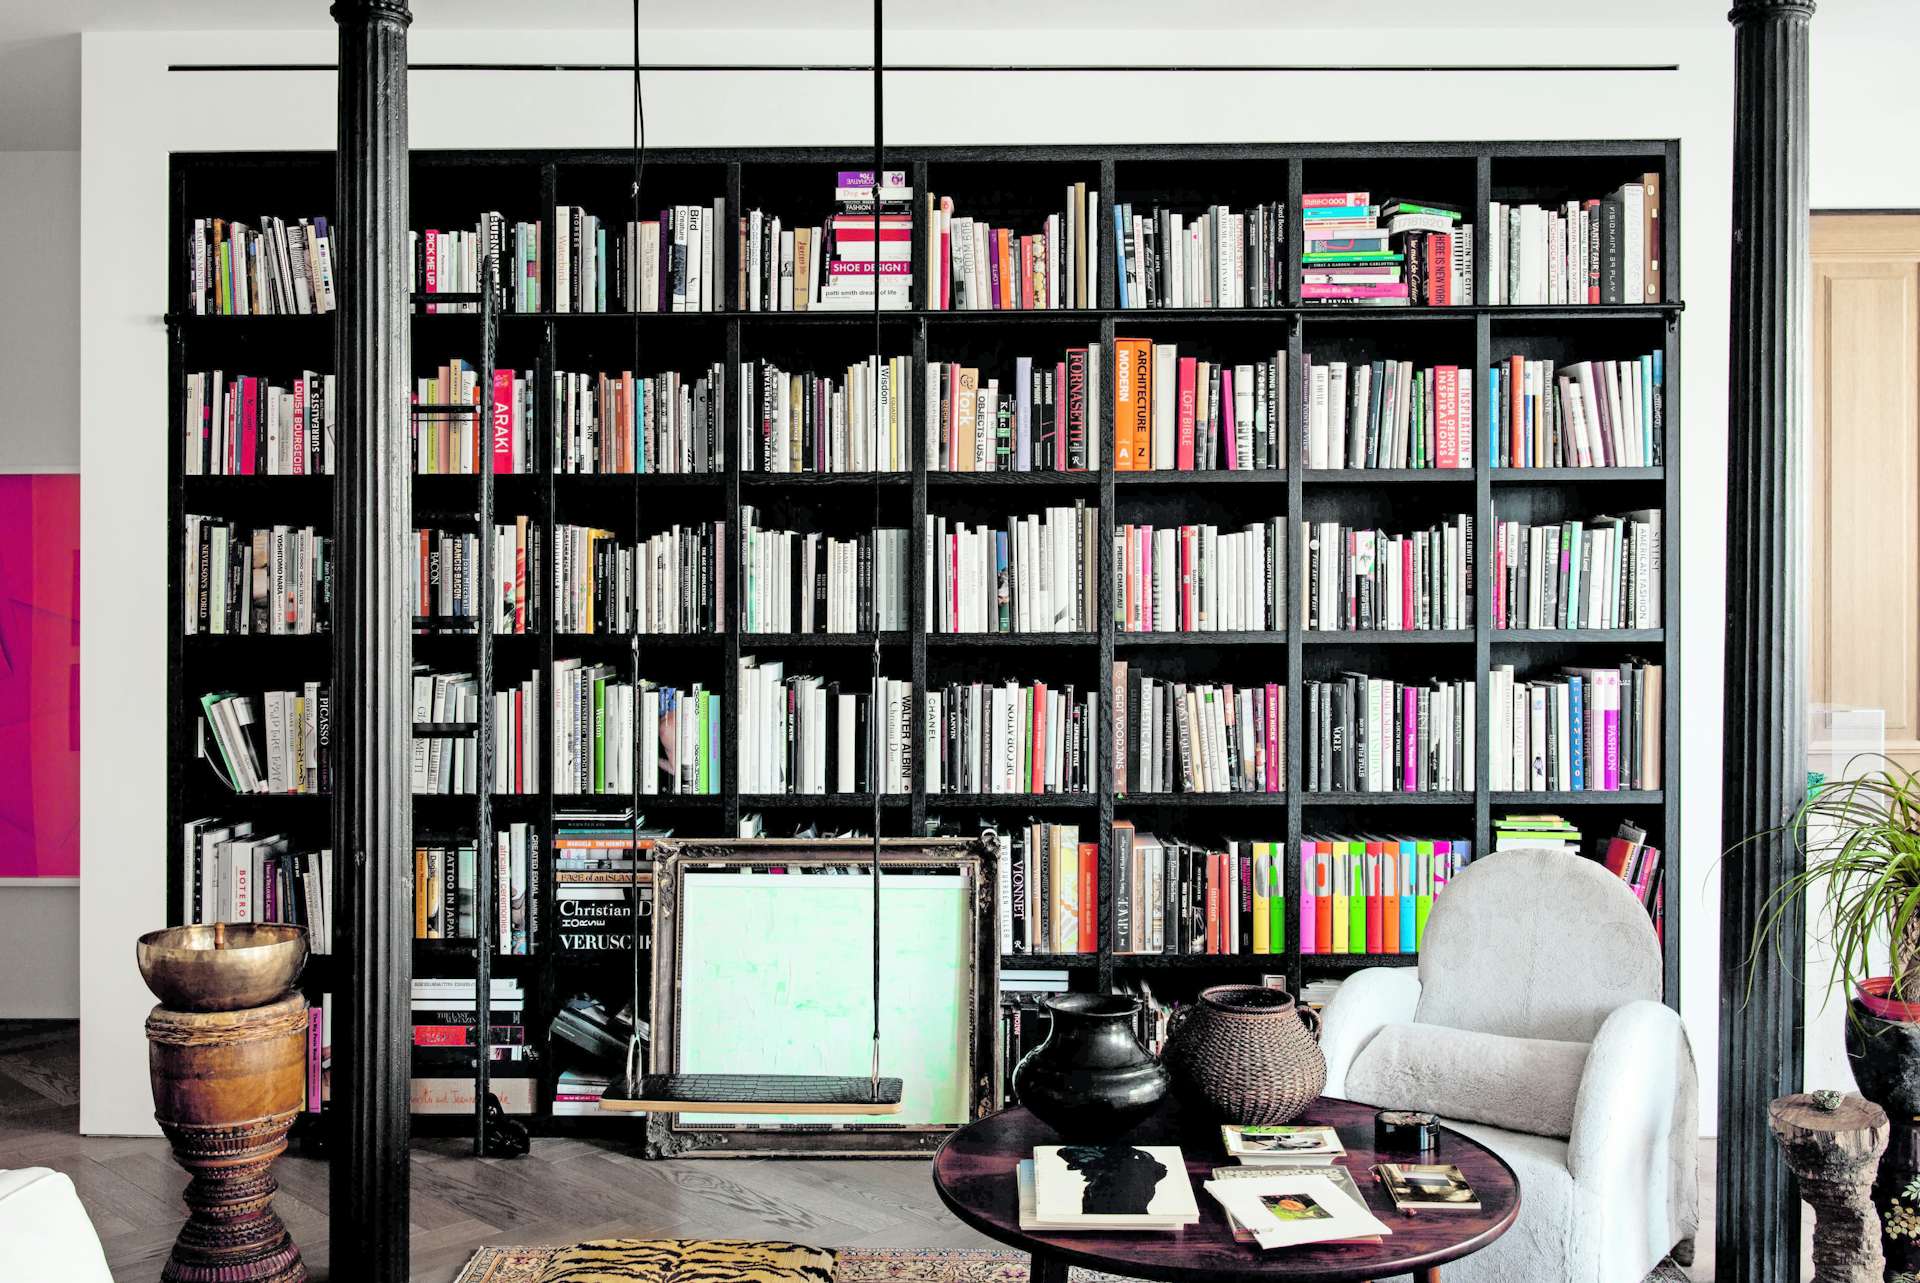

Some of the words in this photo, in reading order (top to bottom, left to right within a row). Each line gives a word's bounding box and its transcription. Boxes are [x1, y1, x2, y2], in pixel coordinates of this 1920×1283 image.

[678, 210, 686, 241] Creature
[689, 209, 700, 231] Bird
[1277, 204, 1285, 220] Tord
[196, 227, 204, 262] MARILYN
[427, 233, 435, 254] PICK
[1277, 220, 1285, 243] Boontje
[1435, 236, 1445, 257] HERE
[197, 263, 205, 290] MINTER
[427, 256, 435, 270] ME
[557, 235, 567, 286] Waterbirds
[833, 264, 860, 272] SHOE
[991, 263, 1000, 286] LOFTS
[1436, 266, 1446, 284] NEW
[427, 272, 436, 285] UP
[1436, 284, 1446, 304] YORK
[881, 368, 889, 405] Wisdom
[1119, 349, 1129, 402] MODERN
[1137, 349, 1147, 432] ARCHITECTURE
[294, 381, 303, 414] LOUISE
[960, 391, 976, 426] fork
[1070, 354, 1083, 442] FORNASETTI
[1182, 390, 1192, 415] LOFT
[311, 393, 320, 452] SURREALISTS
[495, 402, 508, 453] ARAKI
[1182, 417, 1192, 446] BIBLE
[293, 417, 303, 474] BOURGEOIS
[201, 544, 209, 589] NEVELSON'S
[430, 552, 439, 584] BACON
[454, 539, 462, 571] FRANCIS
[1639, 528, 1647, 576] AMERICAN
[454, 573, 462, 599] BACON
[1639, 579, 1647, 620] FASHION
[200, 591, 208, 618] WORLD
[1115, 686, 1124, 714] GERT
[1142, 684, 1150, 738] DOMESTIC
[319, 697, 329, 745] PICASSO
[595, 707, 604, 738] Weston
[890, 701, 899, 740] Christian
[901, 695, 911, 741] WALTER
[928, 698, 936, 742] CHANEL
[890, 743, 898, 762] Dior
[1006, 704, 1015, 776] DECORATION
[1115, 716, 1124, 769] VOORJANS
[1333, 726, 1344, 752] VOGUE
[1358, 743, 1366, 756] FILE
[1607, 725, 1616, 771] FASHION
[901, 743, 911, 778] ALBINI
[1358, 757, 1366, 777] STYLE
[498, 844, 508, 875] african
[531, 835, 539, 869] CREATED
[446, 851, 454, 889] TATTOO
[531, 871, 539, 896] EQUAL
[239, 870, 247, 917] BOTERO
[446, 892, 454, 903] IN
[1012, 860, 1024, 920] VIONNET
[446, 906, 454, 938] JAPAN
[500, 882, 508, 934] ceremonies
[560, 901, 630, 916] Christian
[559, 934, 652, 949] VERUSC
